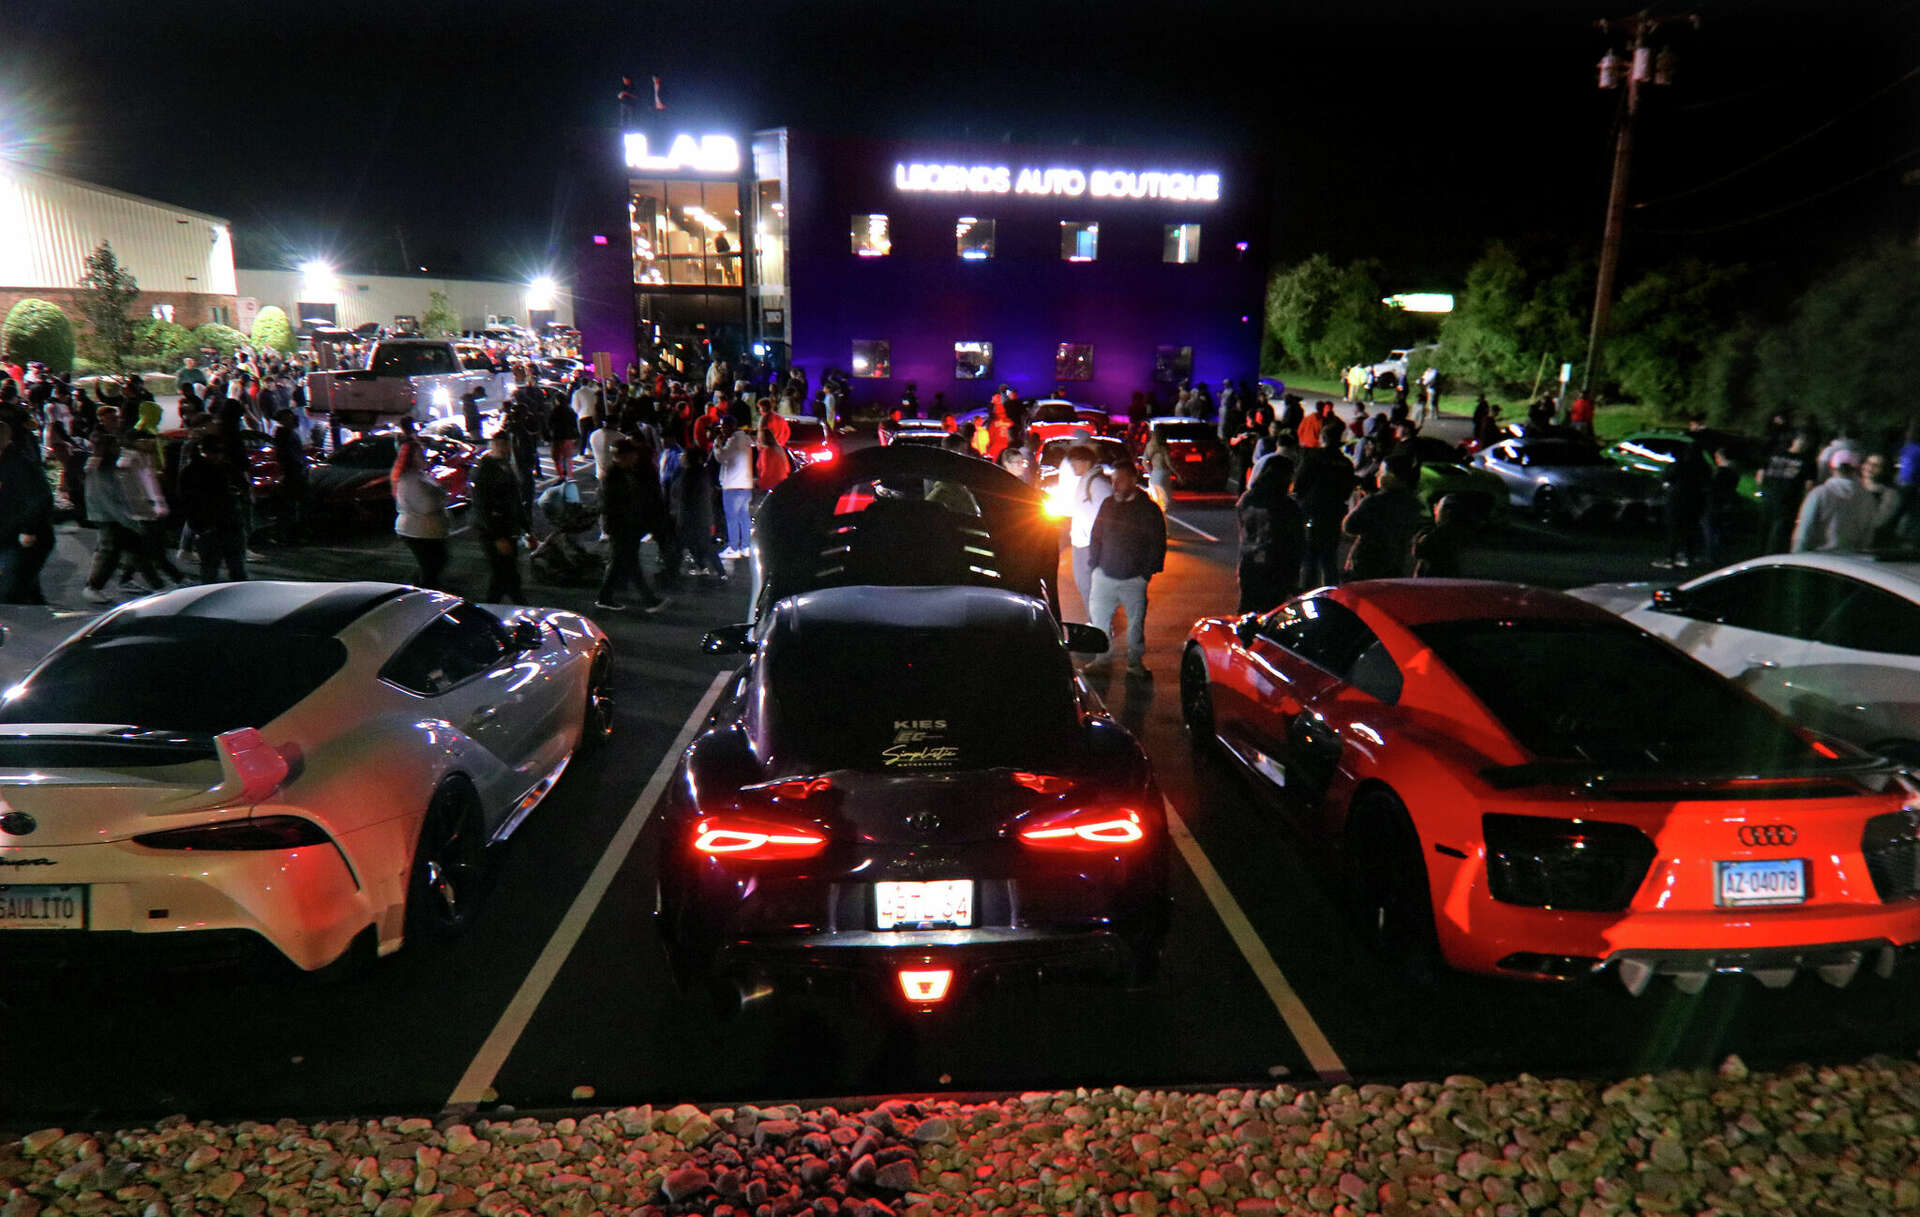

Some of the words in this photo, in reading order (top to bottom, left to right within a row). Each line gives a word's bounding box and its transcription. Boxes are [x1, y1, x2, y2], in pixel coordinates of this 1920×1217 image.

[895, 163, 1010, 193] LEGENDS
[1015, 168, 1086, 196] AUTO
[1090, 170, 1220, 201] BOUTIQUE
